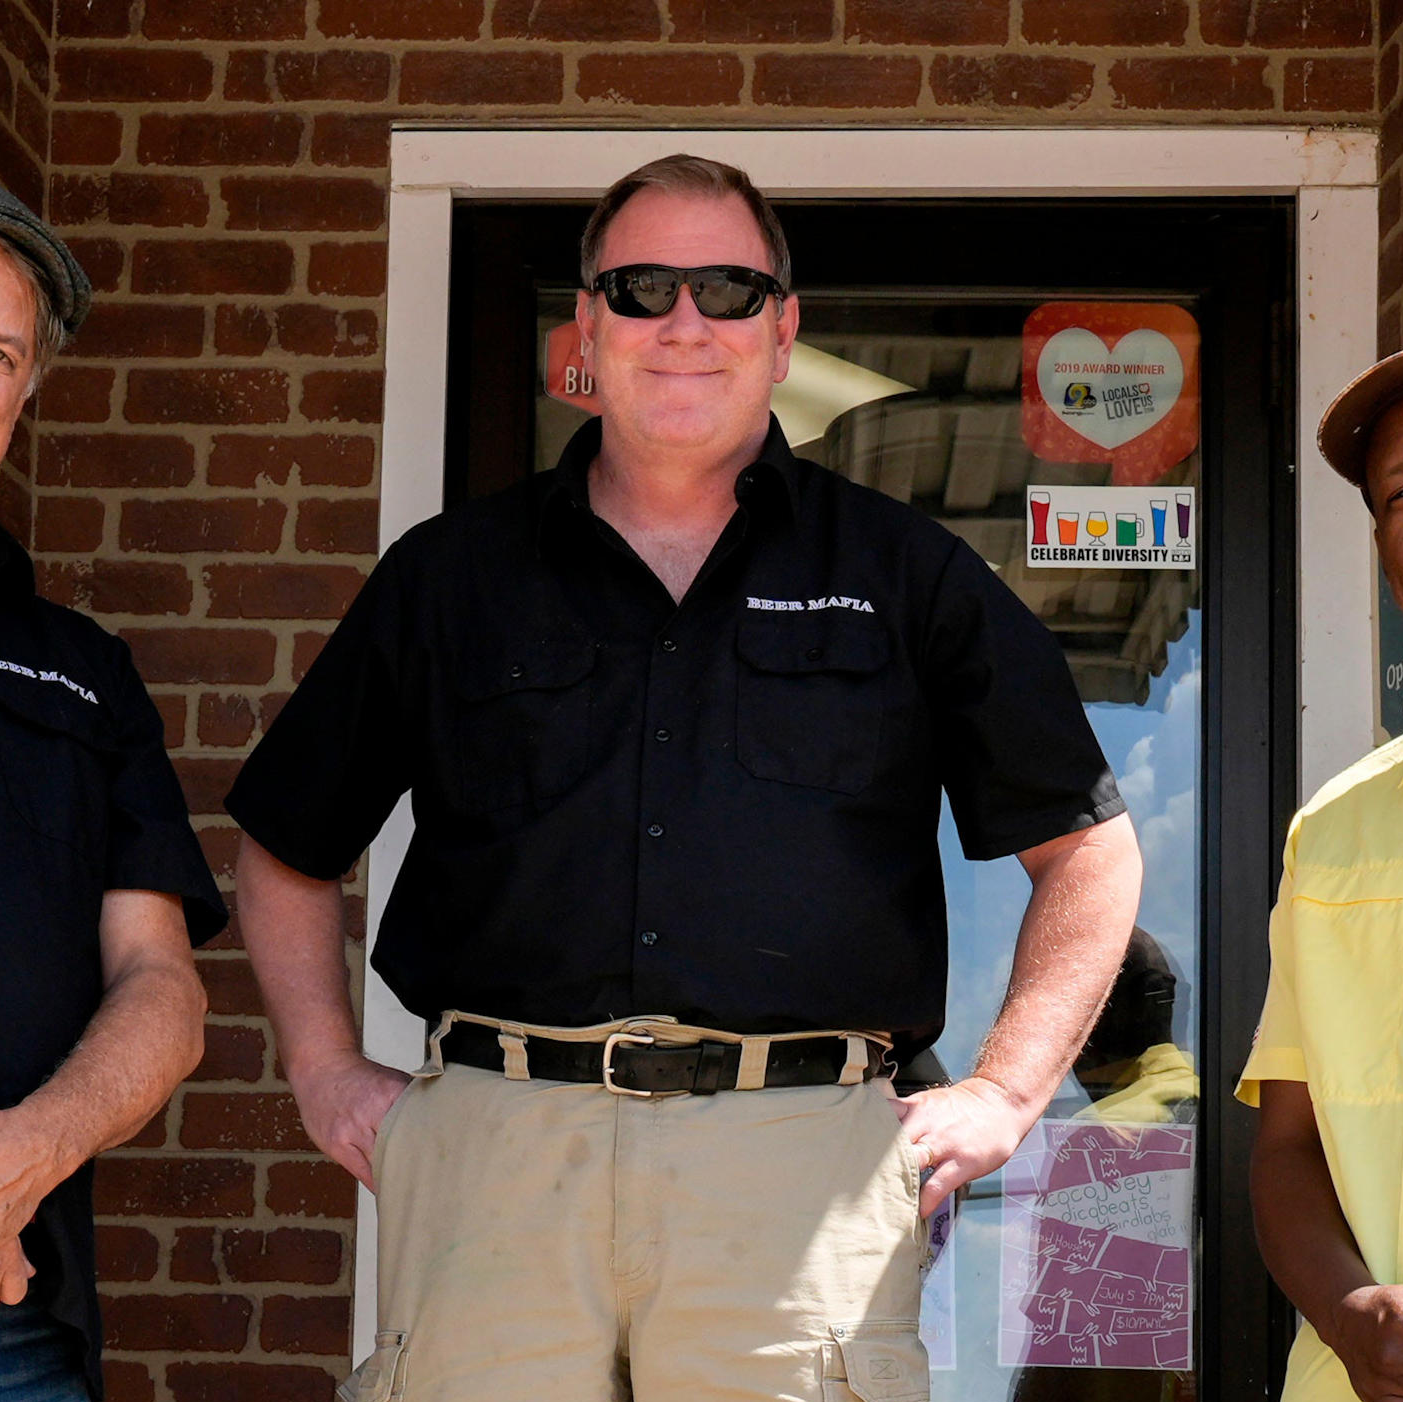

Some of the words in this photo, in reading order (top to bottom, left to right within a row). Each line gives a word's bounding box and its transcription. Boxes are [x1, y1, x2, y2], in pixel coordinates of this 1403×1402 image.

[1054, 363, 1080, 373] 2019
[1082, 363, 1121, 374] AWARD
[1123, 364, 1165, 375] WINNER
[565, 365, 593, 395] BU
[1102, 384, 1139, 402] LOCALS
[1105, 398, 1143, 420] LOVE
[1141, 395, 1154, 408] US
[1031, 547, 1098, 561] CELEBRATE
[1102, 549, 1168, 562] DIVERSITY
[746, 597, 805, 611] BEER
[807, 596, 875, 613] MAFIA
[38, 670, 99, 704] MAFIA
[1099, 1287, 1125, 1304] July
[1141, 1291, 1164, 1306] 7PM
